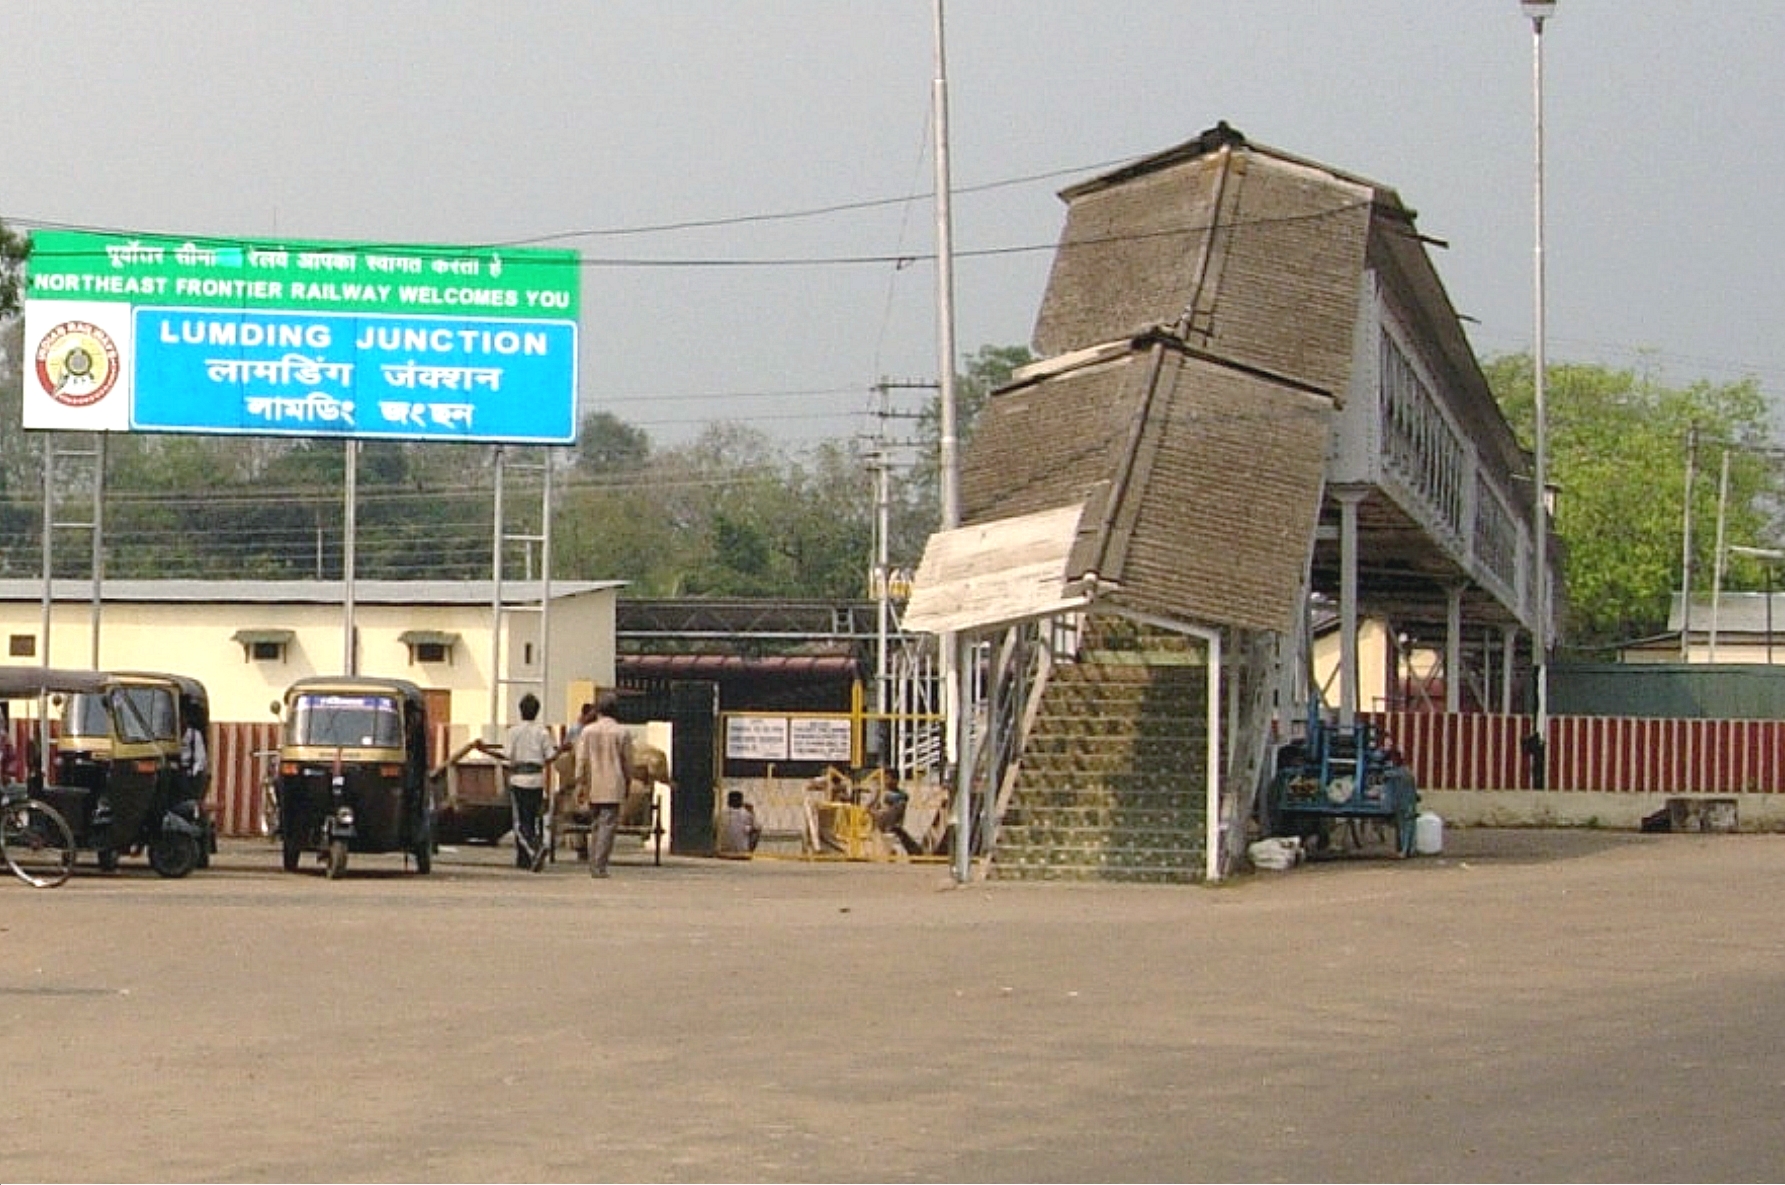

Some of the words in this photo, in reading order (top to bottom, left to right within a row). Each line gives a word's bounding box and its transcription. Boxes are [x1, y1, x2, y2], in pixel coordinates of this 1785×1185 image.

[35, 274, 167, 295] NORTHEAST
[175, 277, 283, 300] FRONTIER
[290, 281, 392, 302] RAILWAY
[399, 285, 518, 308] WELCOMES
[526, 289, 570, 309] YOU
[160, 321, 331, 348] LUMDING
[356, 327, 547, 356] JUNCTION
[205, 353, 354, 386] लामडिंग
